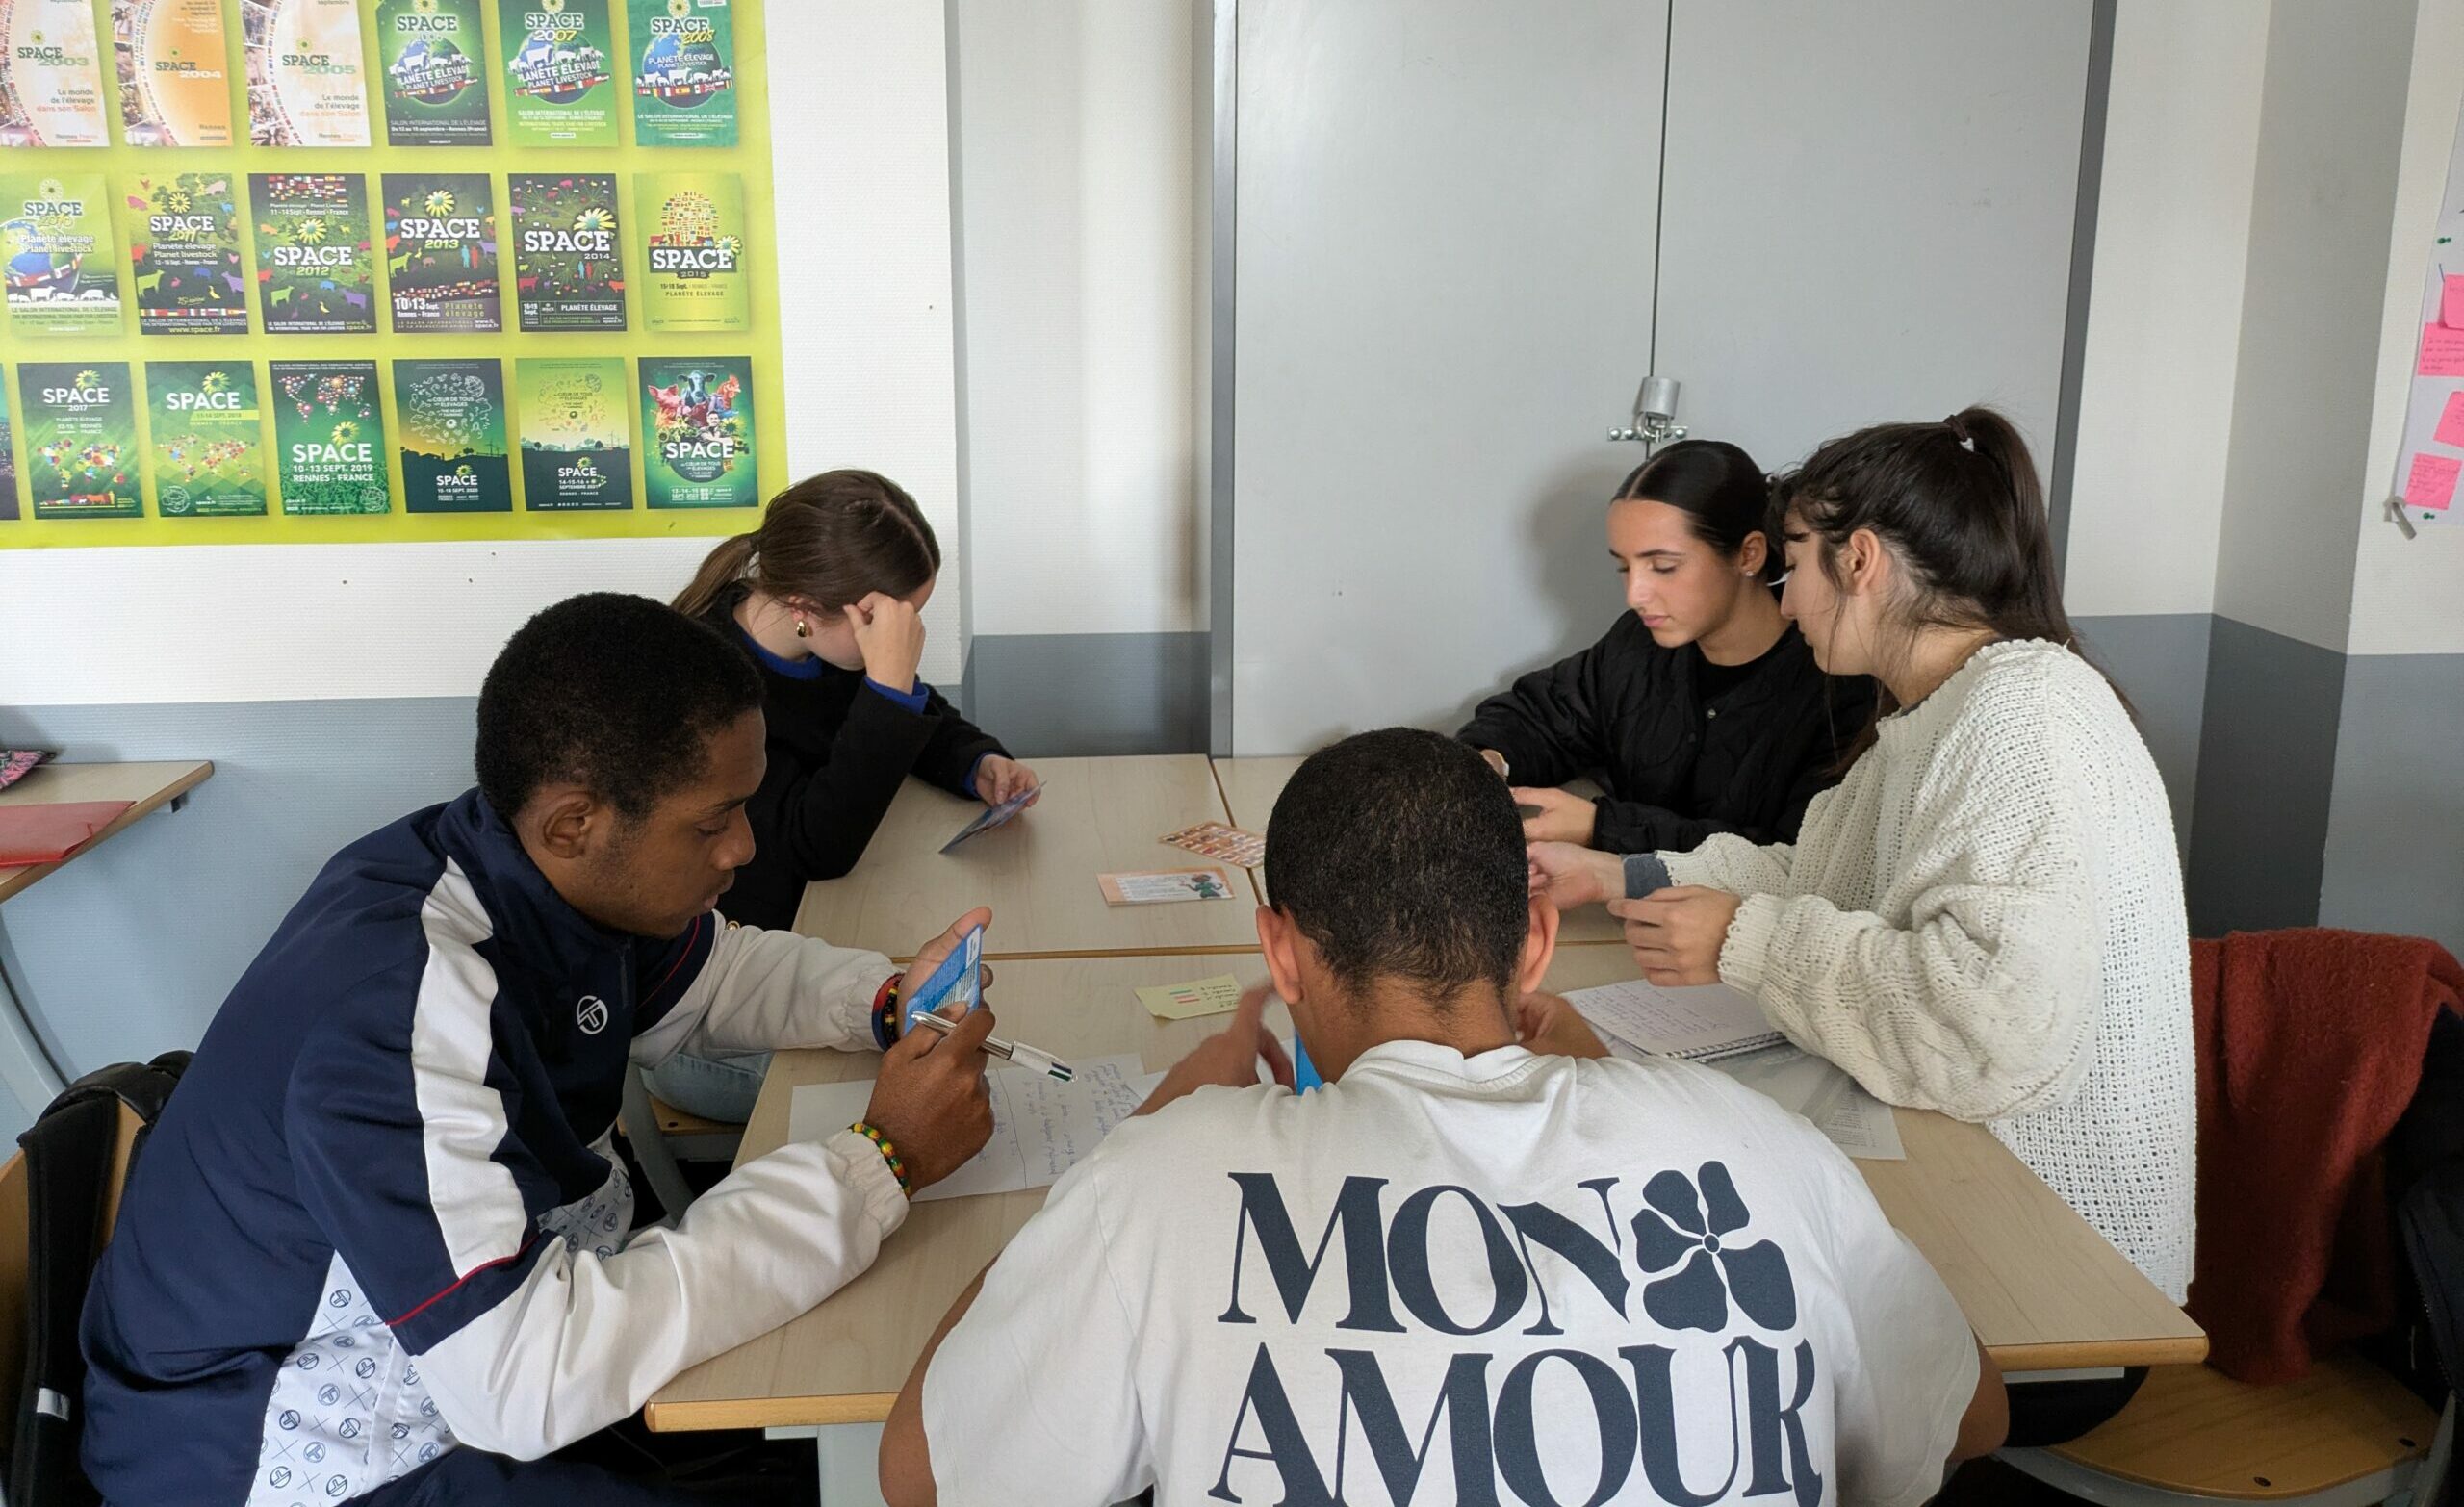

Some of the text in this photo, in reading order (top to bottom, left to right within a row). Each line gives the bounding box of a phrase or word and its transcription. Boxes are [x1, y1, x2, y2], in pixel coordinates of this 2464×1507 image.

[397, 15, 458, 31] SPACE
[526, 13, 583, 28] SPACE
[652, 19, 708, 33] SPACE
[533, 30, 578, 41] 2007
[682, 29, 715, 45] 2008
[17, 47, 63, 58] SPACE
[38, 57, 90, 66] 2003
[155, 62, 196, 71] SPACE
[282, 55, 330, 66] SPACE
[303, 65, 356, 74] 2005
[24, 201, 83, 216] SPACE
[150, 215, 215, 232] SPACE
[400, 218, 481, 239] SPACE
[424, 239, 460, 249] 2013
[524, 231, 611, 252] SPACE
[273, 246, 353, 266] SPACE
[652, 249, 732, 269] SPACE
[296, 266, 330, 276] 2012
[43, 387, 111, 403] SPACE
[166, 392, 242, 410] SPACE
[293, 443, 372, 463] SPACE
[665, 442, 734, 458] SPACE
[558, 467, 597, 477] SPACE
[436, 475, 478, 486] SPACE
[1218, 1171, 1631, 1337] MON
[1208, 1334, 1824, 1507] AMOUR
